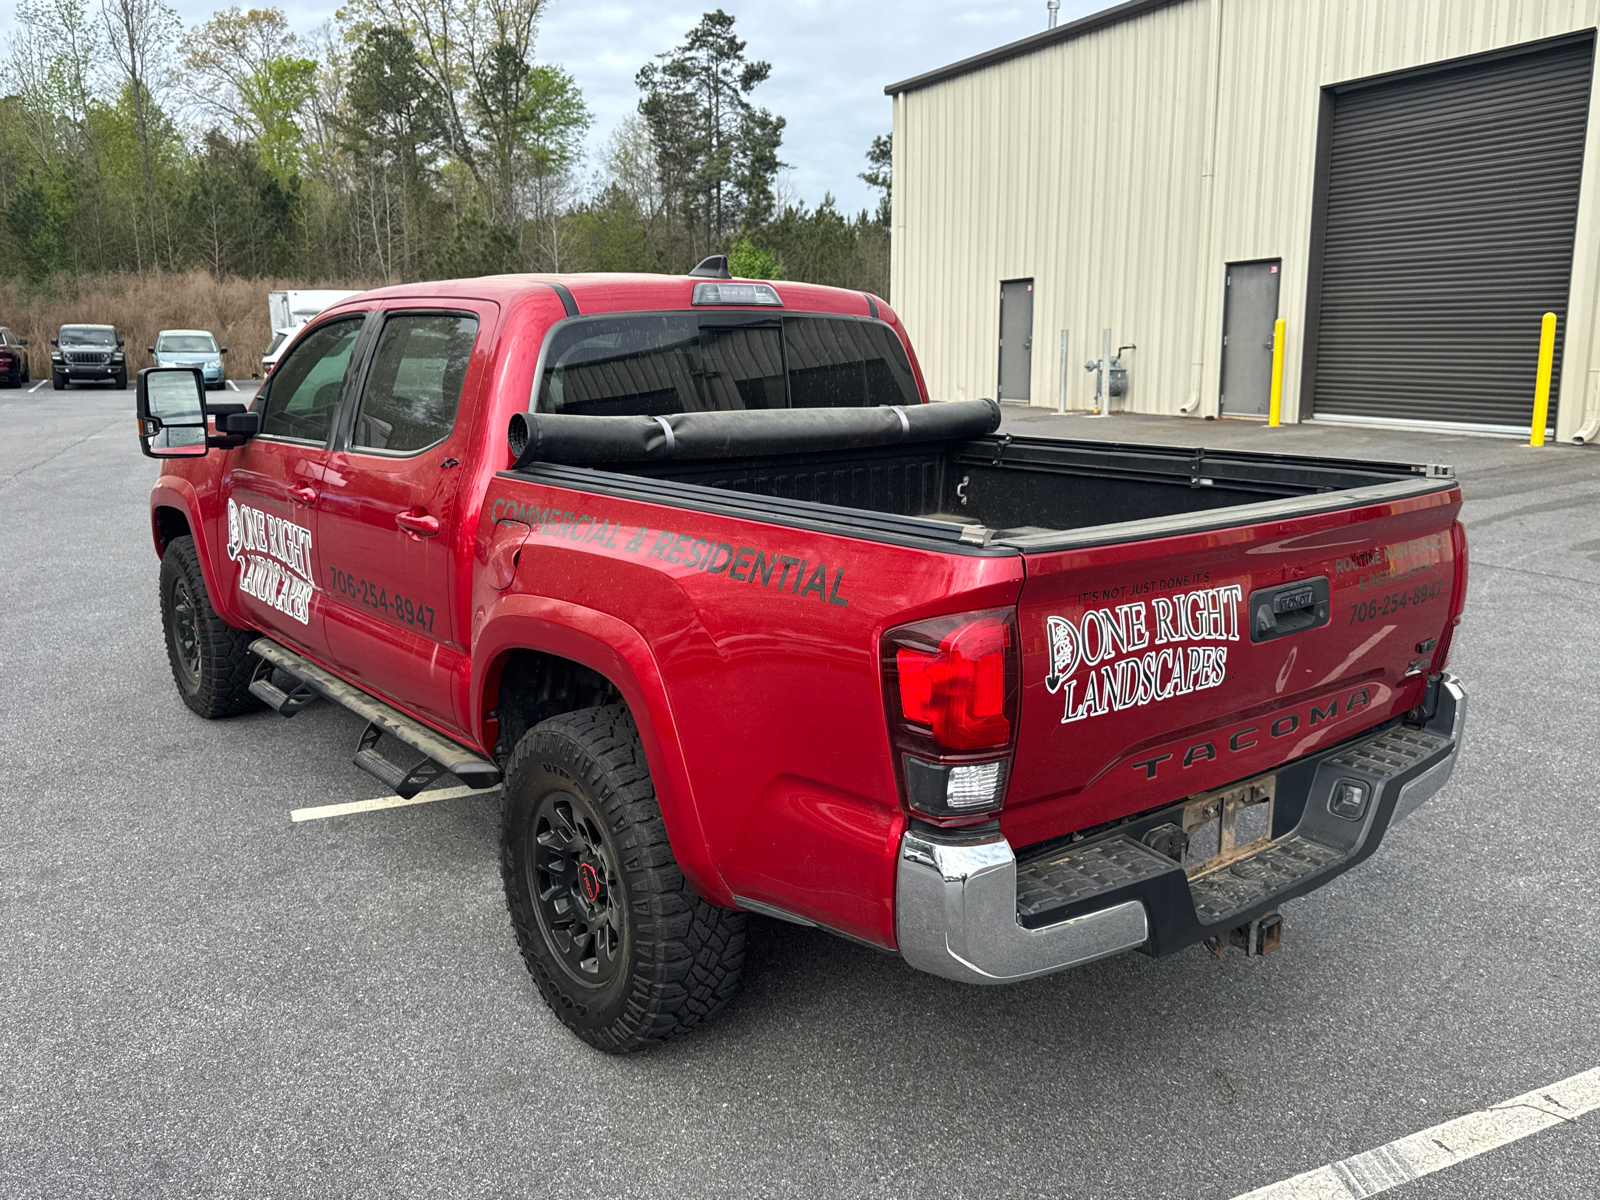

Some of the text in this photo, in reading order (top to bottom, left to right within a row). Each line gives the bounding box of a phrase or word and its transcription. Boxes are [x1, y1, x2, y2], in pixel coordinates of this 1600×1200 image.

[227, 498, 315, 586] DONE RIGHT
[491, 498, 849, 607] COMMERCIAL & RESIDENTIAL
[1335, 534, 1447, 574] ROUTINE MAINTENANCE
[1369, 559, 1433, 589] INSTALLATION
[237, 556, 313, 625] LANDSCAPES
[330, 567, 435, 633] 706-254-8947
[1077, 571, 1210, 605] IT'S NOT JUST DONE IT'S
[1349, 580, 1443, 626] 706-254-8947
[1046, 584, 1242, 694] DONE RIGHT
[1061, 647, 1227, 724] LANDSCAPES
[1132, 689, 1370, 780] TACOMA
[582, 867, 593, 898] TRD
